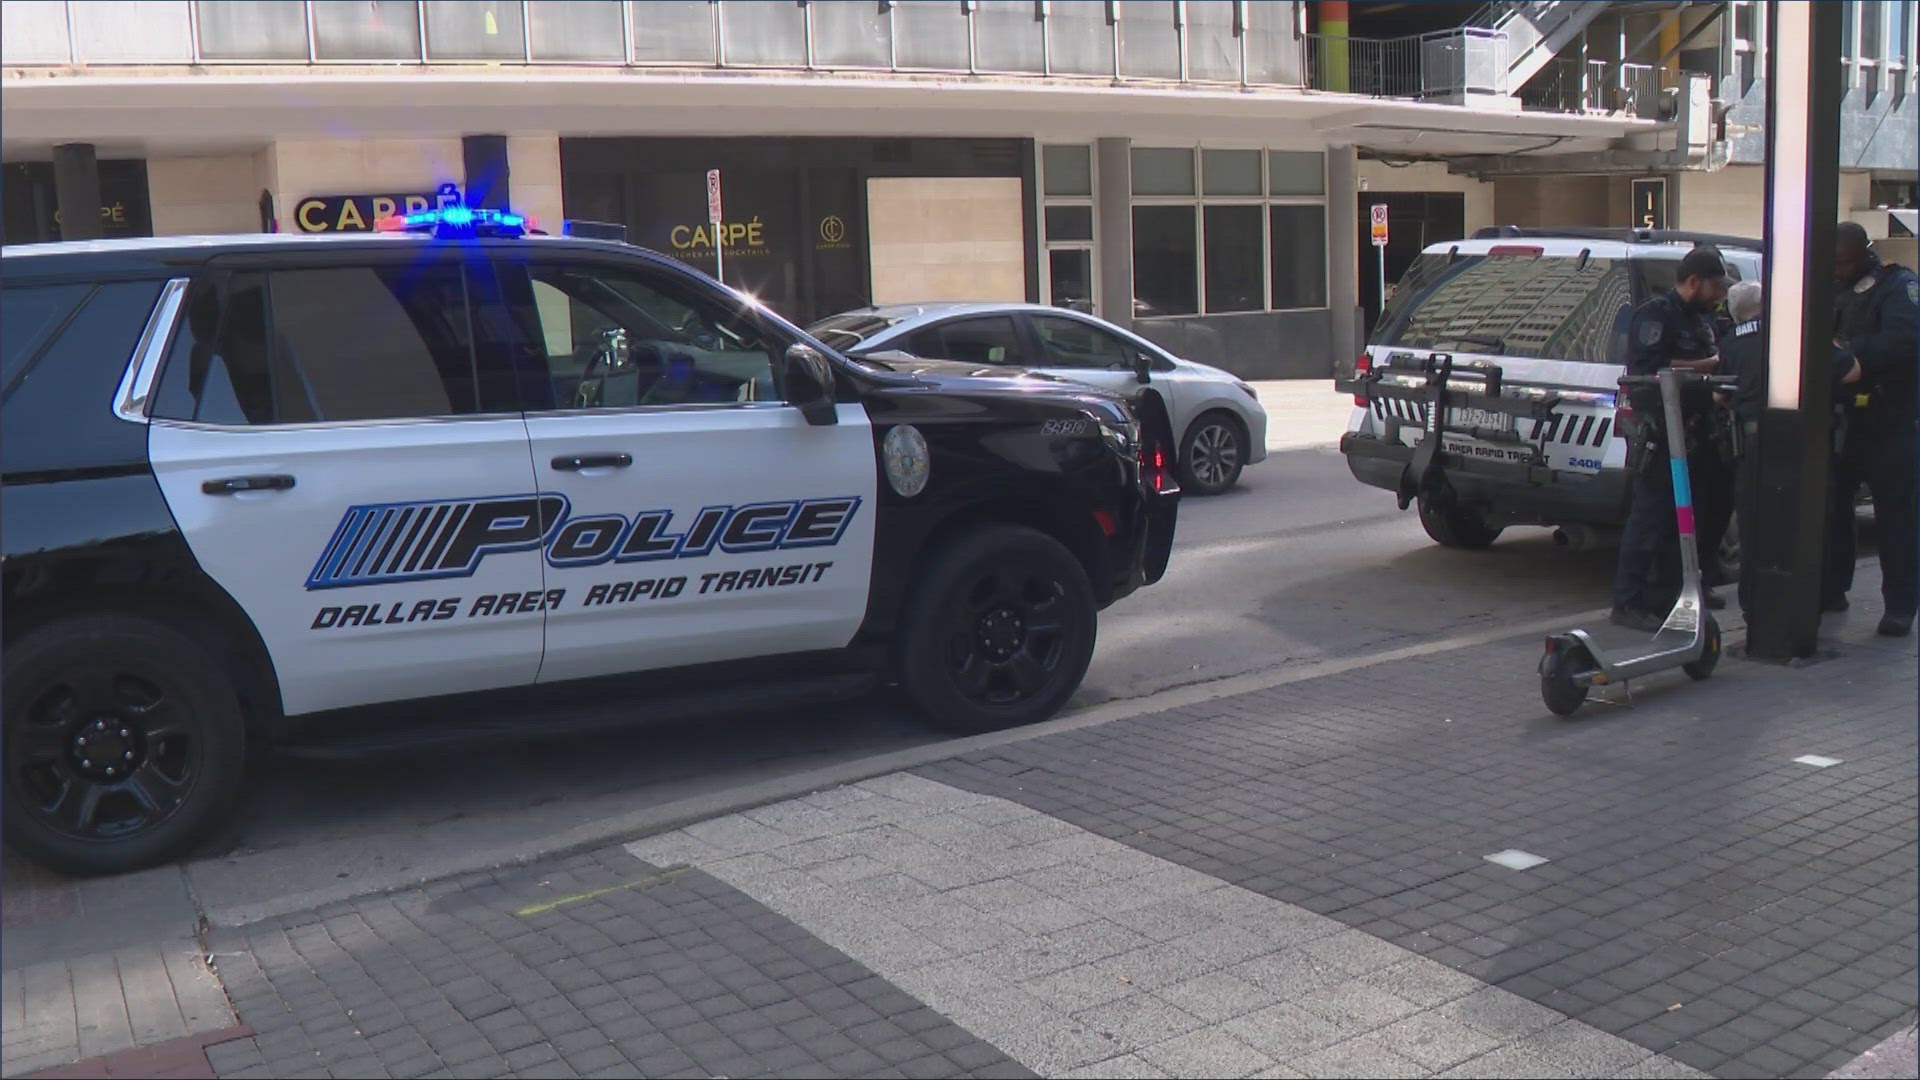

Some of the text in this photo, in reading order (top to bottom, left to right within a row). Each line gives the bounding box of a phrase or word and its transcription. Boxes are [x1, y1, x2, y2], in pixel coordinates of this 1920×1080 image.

[54, 201, 125, 224] CPÉ
[670, 215, 764, 249] CARPÉ
[1735, 320, 1758, 337] DART
[437, 491, 862, 577] POLICE
[311, 561, 834, 630] DALLAS AREA RAPID TRANSIT
